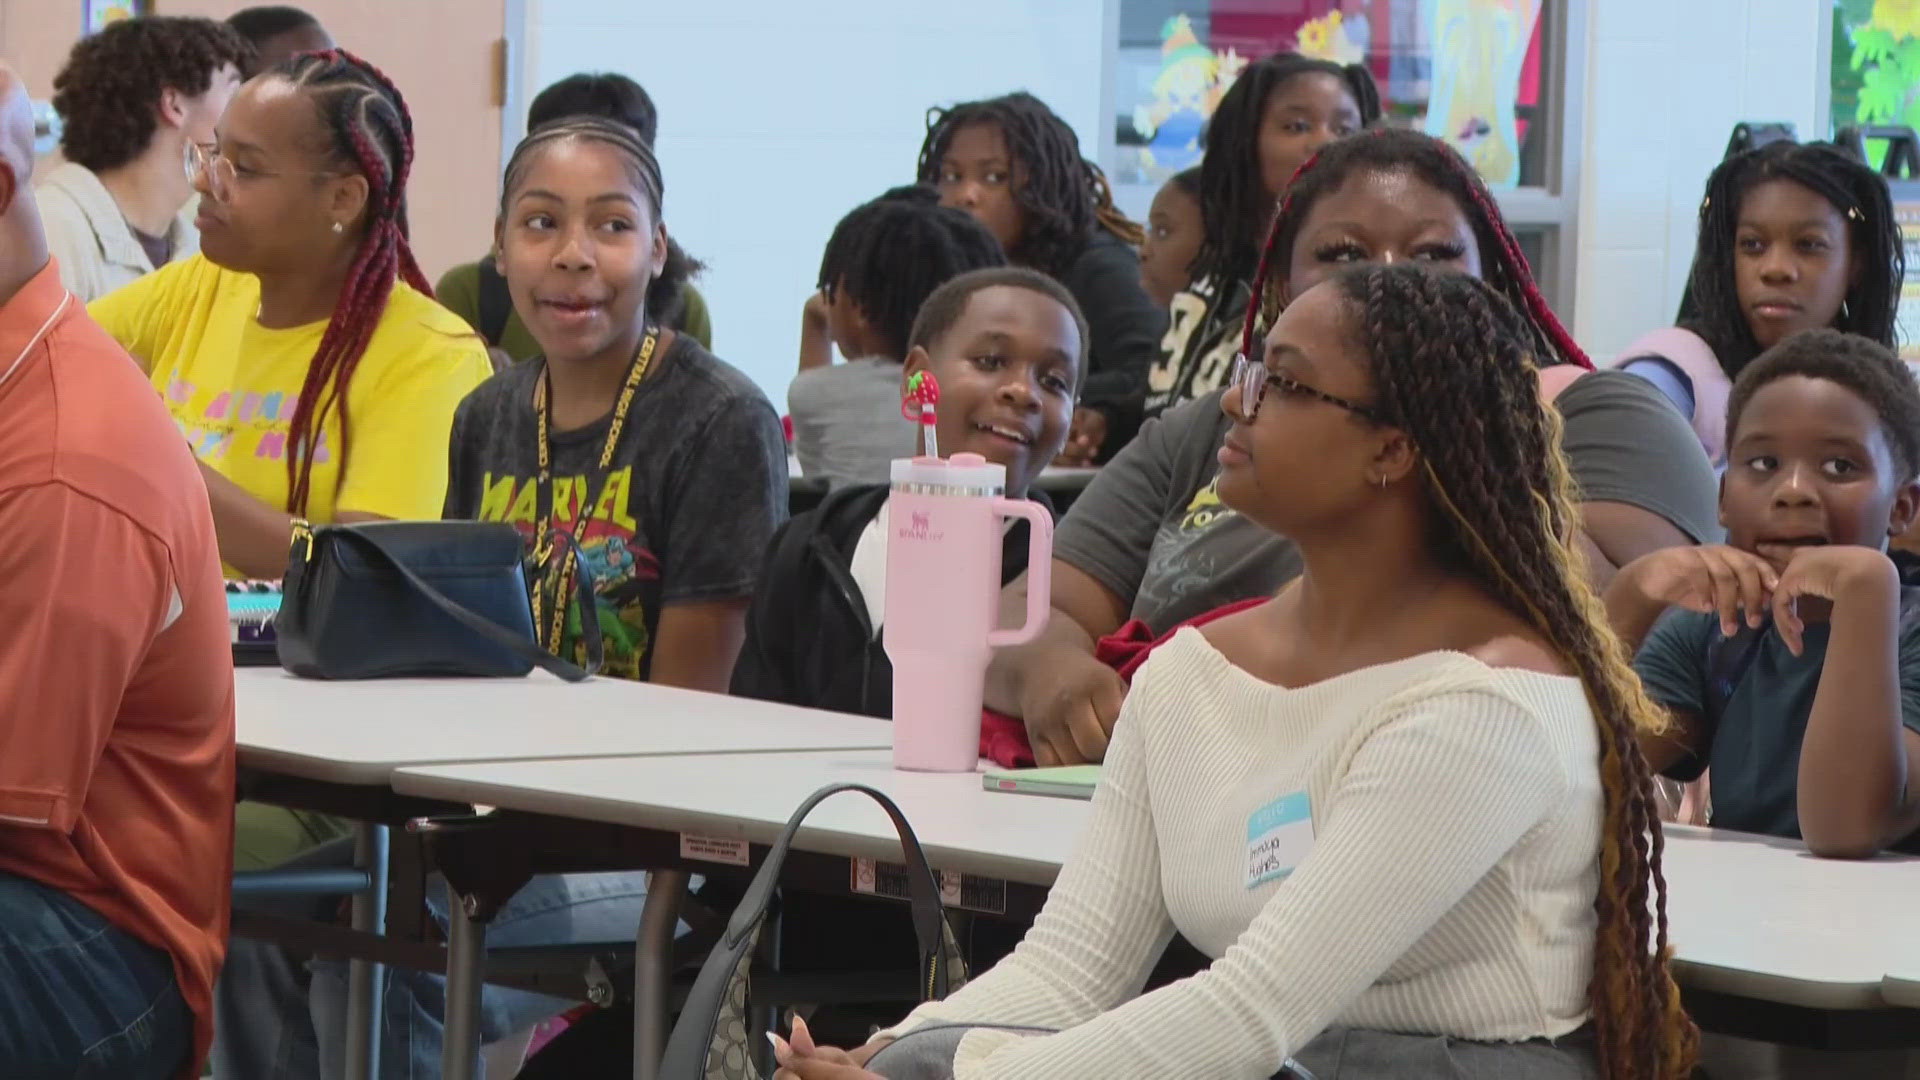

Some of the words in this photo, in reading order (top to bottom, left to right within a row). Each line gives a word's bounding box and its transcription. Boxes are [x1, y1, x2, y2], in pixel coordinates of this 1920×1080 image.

[626, 335, 656, 387] CENTRAL
[614, 388, 635, 418] HIGH
[599, 419, 623, 469] SCHOOL
[549, 610, 565, 656] SCHOO
